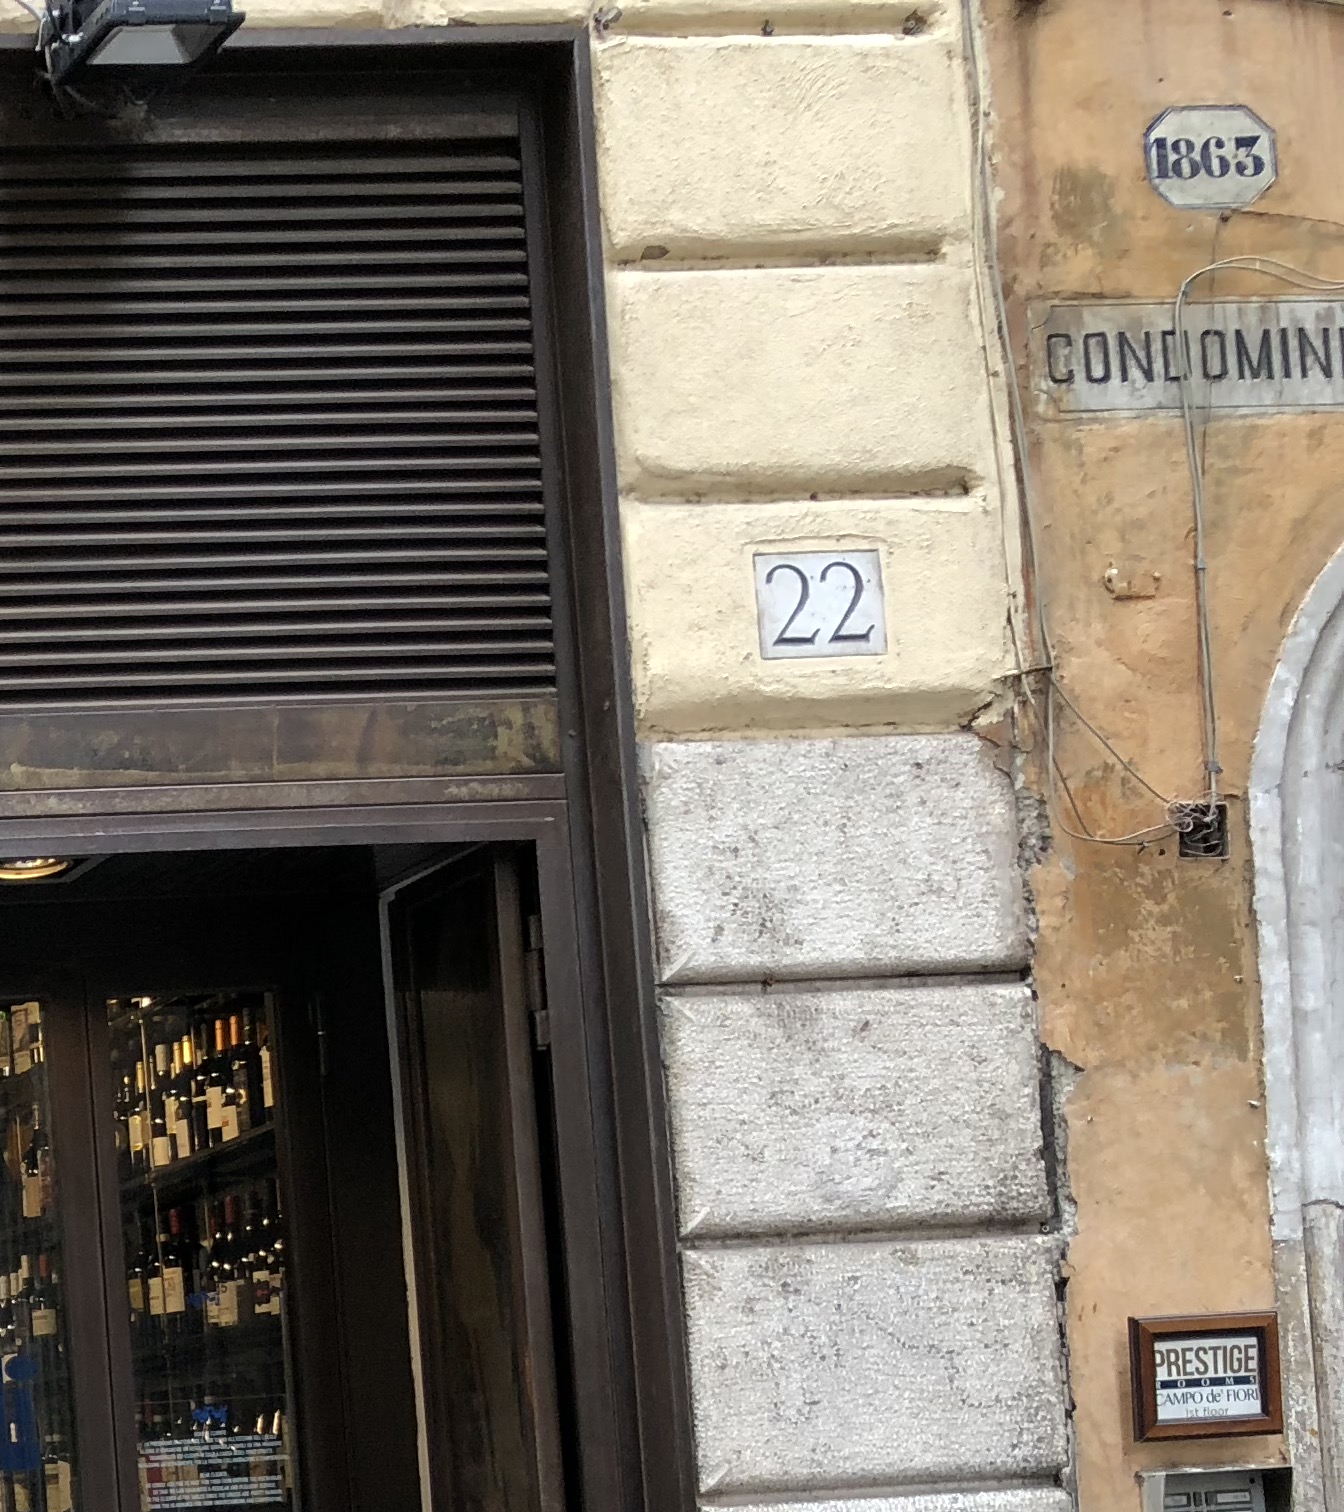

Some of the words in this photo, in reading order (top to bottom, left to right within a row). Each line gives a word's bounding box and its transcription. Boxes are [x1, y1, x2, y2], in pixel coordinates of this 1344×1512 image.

[1149, 136, 1265, 181] 1863
[765, 561, 876, 648] 22
[1154, 1344, 1257, 1378] PRESTIGE
[1156, 1391, 1204, 1407] CAMPO
[1226, 1387, 1259, 1403] FIORI
